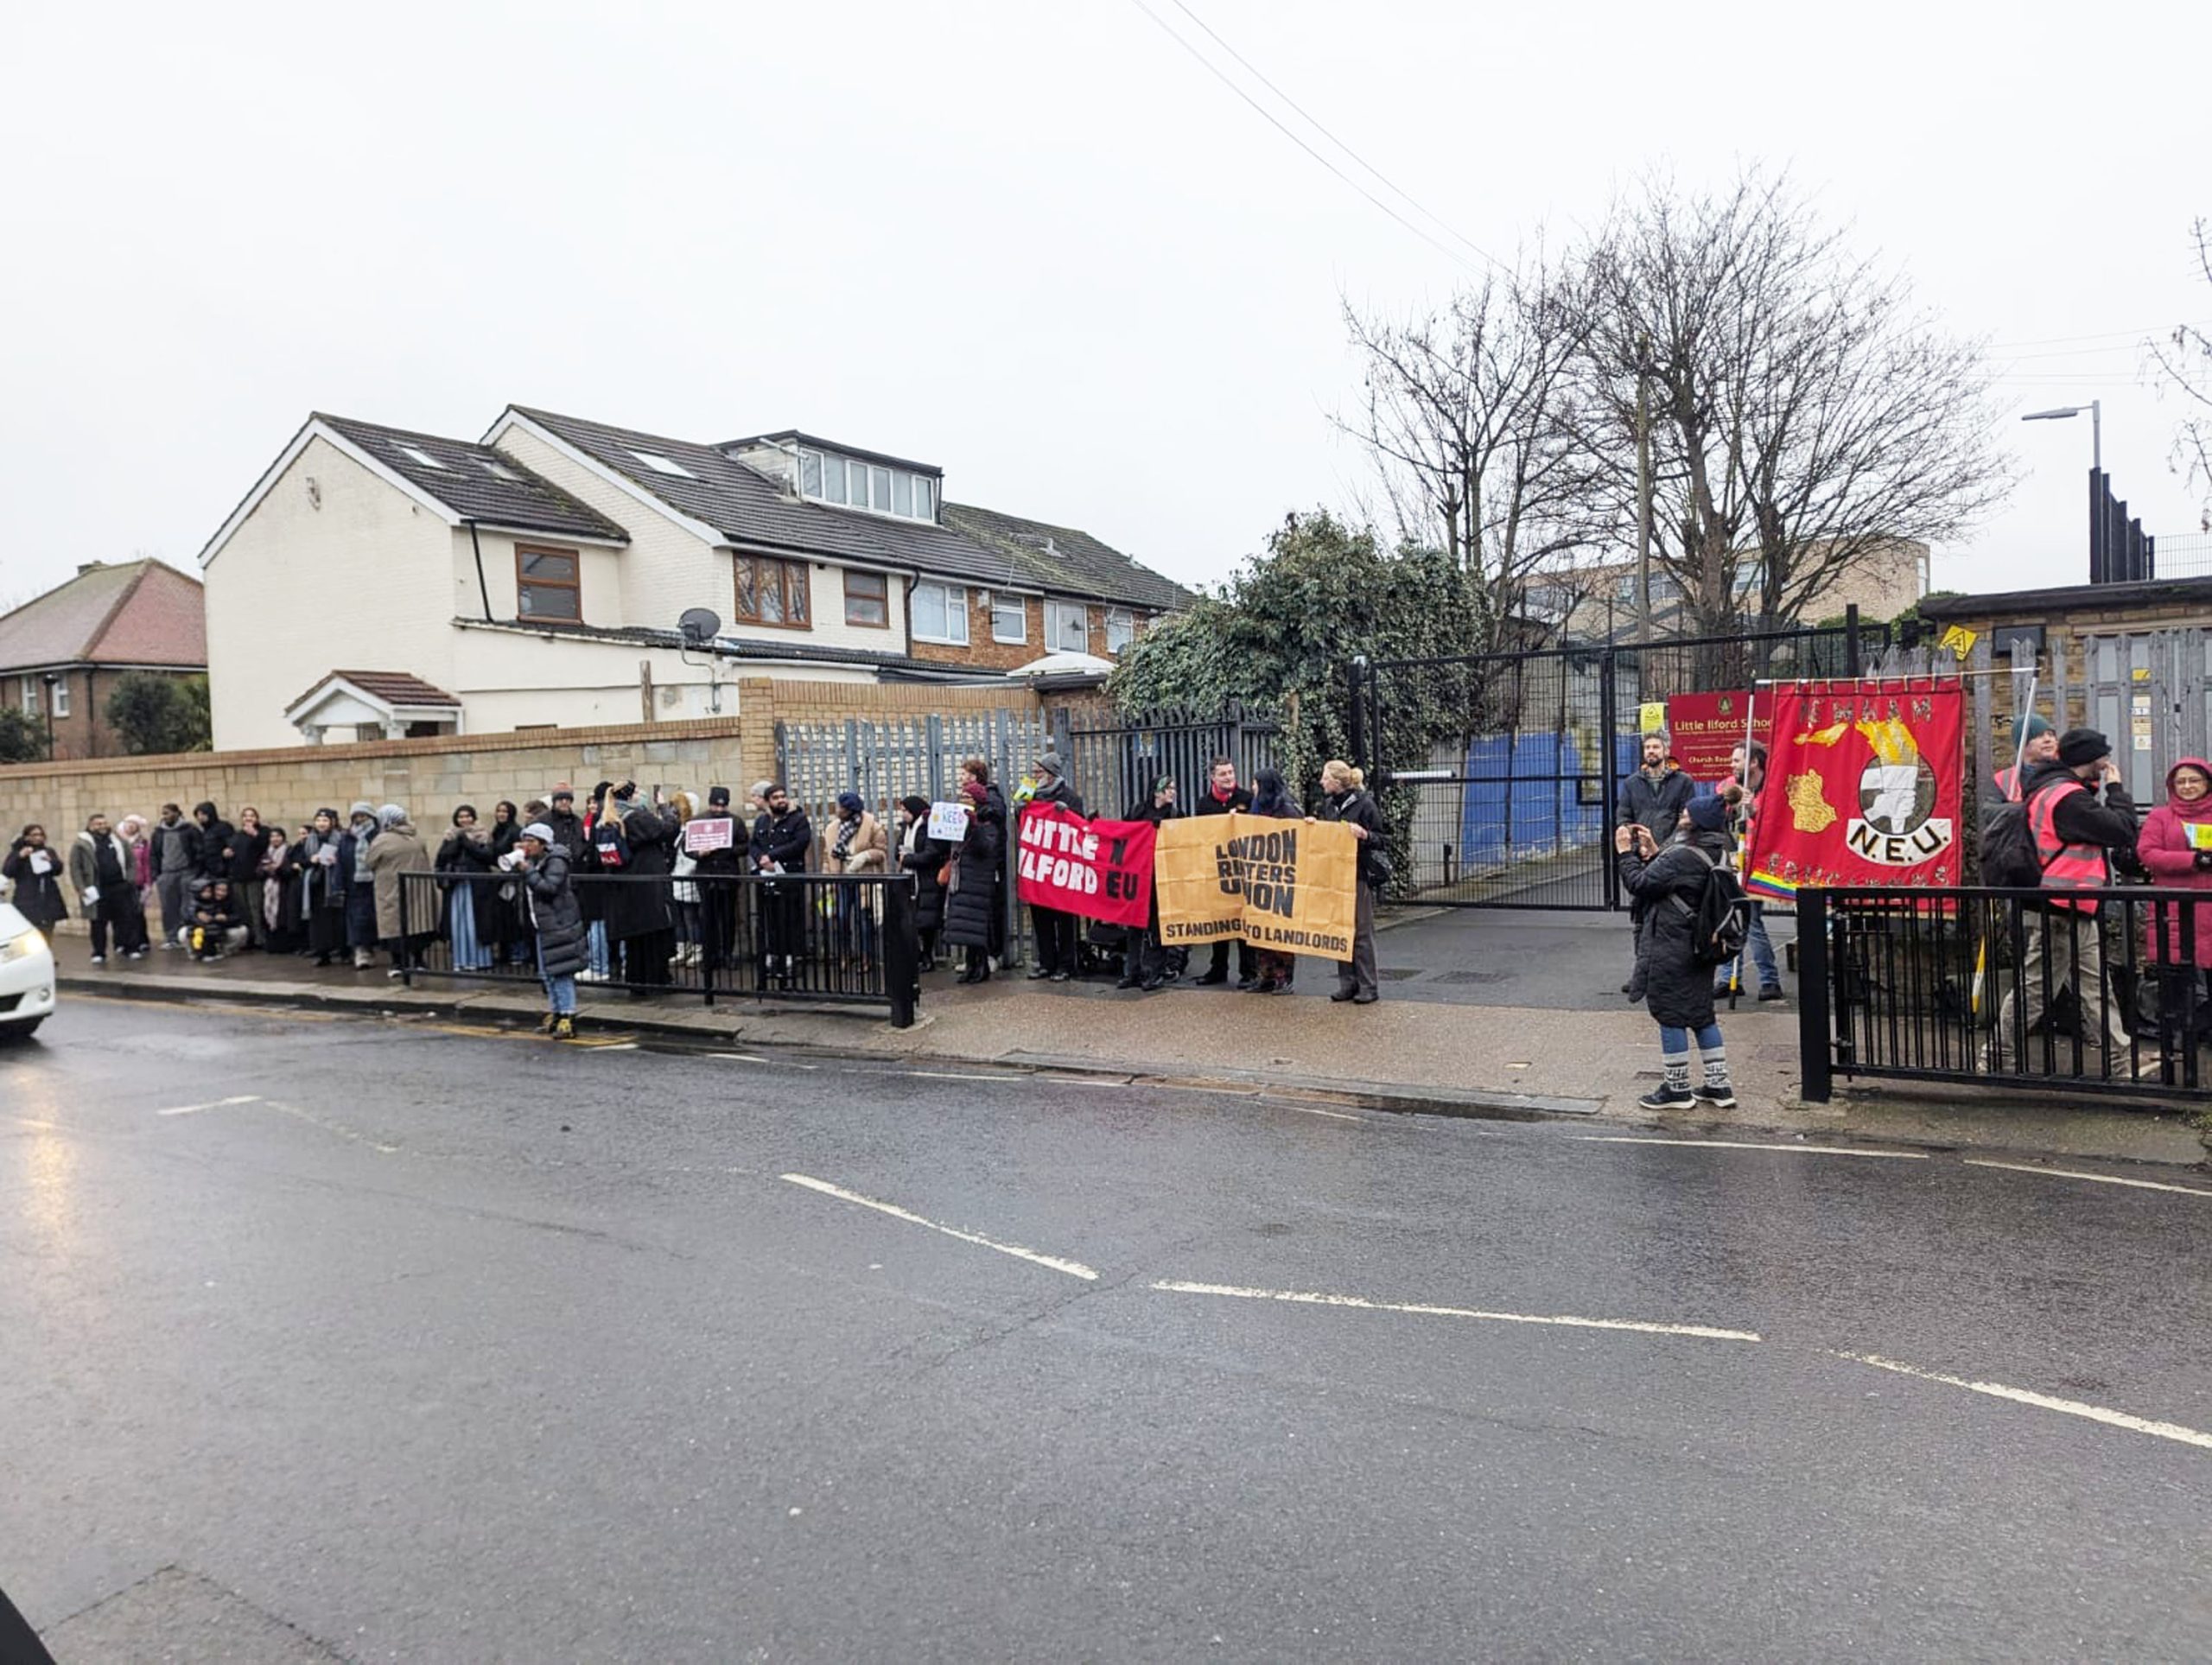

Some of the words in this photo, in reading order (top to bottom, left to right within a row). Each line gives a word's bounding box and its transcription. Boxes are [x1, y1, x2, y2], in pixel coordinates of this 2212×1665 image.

[1675, 720, 1704, 731] Little
[1708, 719, 1738, 730] Ilford
[1020, 816, 1099, 861] LITTLE
[1110, 838, 1128, 866] N
[1216, 828, 1297, 865] LONDON
[1849, 824, 1948, 861] N.E.U.
[1107, 871, 1138, 900] EU
[1166, 918, 1242, 937] STANDING
[1265, 926, 1348, 953] LANDLORDS
